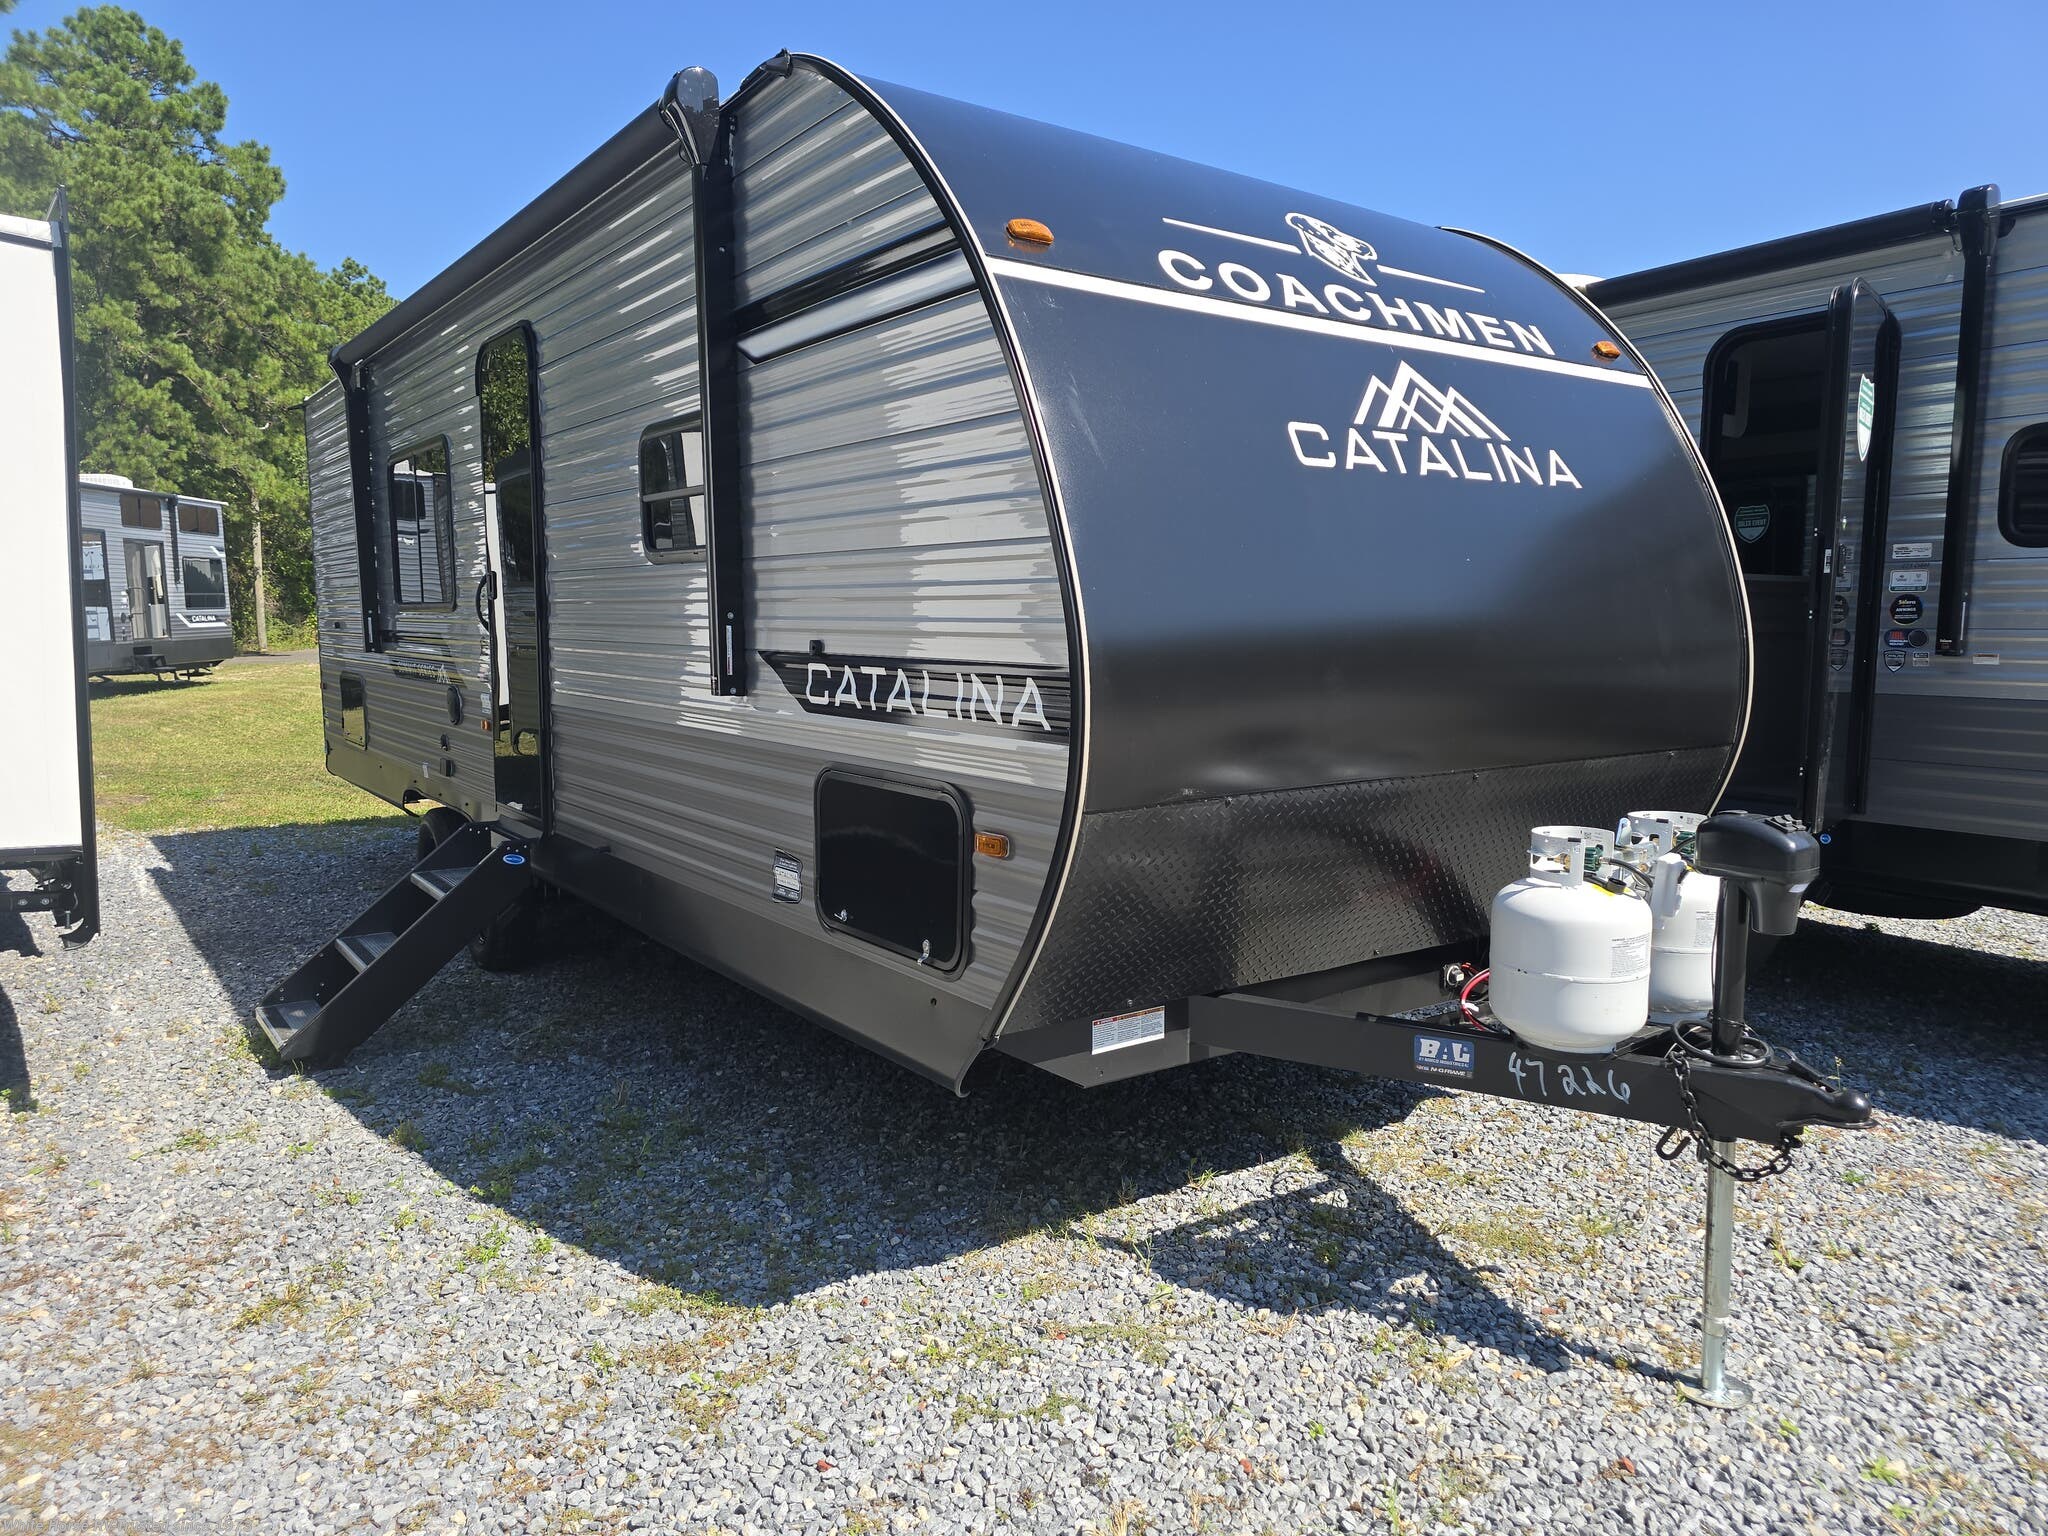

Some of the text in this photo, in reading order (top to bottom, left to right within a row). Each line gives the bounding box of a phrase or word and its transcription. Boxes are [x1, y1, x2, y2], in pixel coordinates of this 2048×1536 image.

[1157, 248, 1556, 356] COACHMEN
[1287, 420, 1583, 490] CATALINA
[805, 662, 1052, 732] CATALINA
